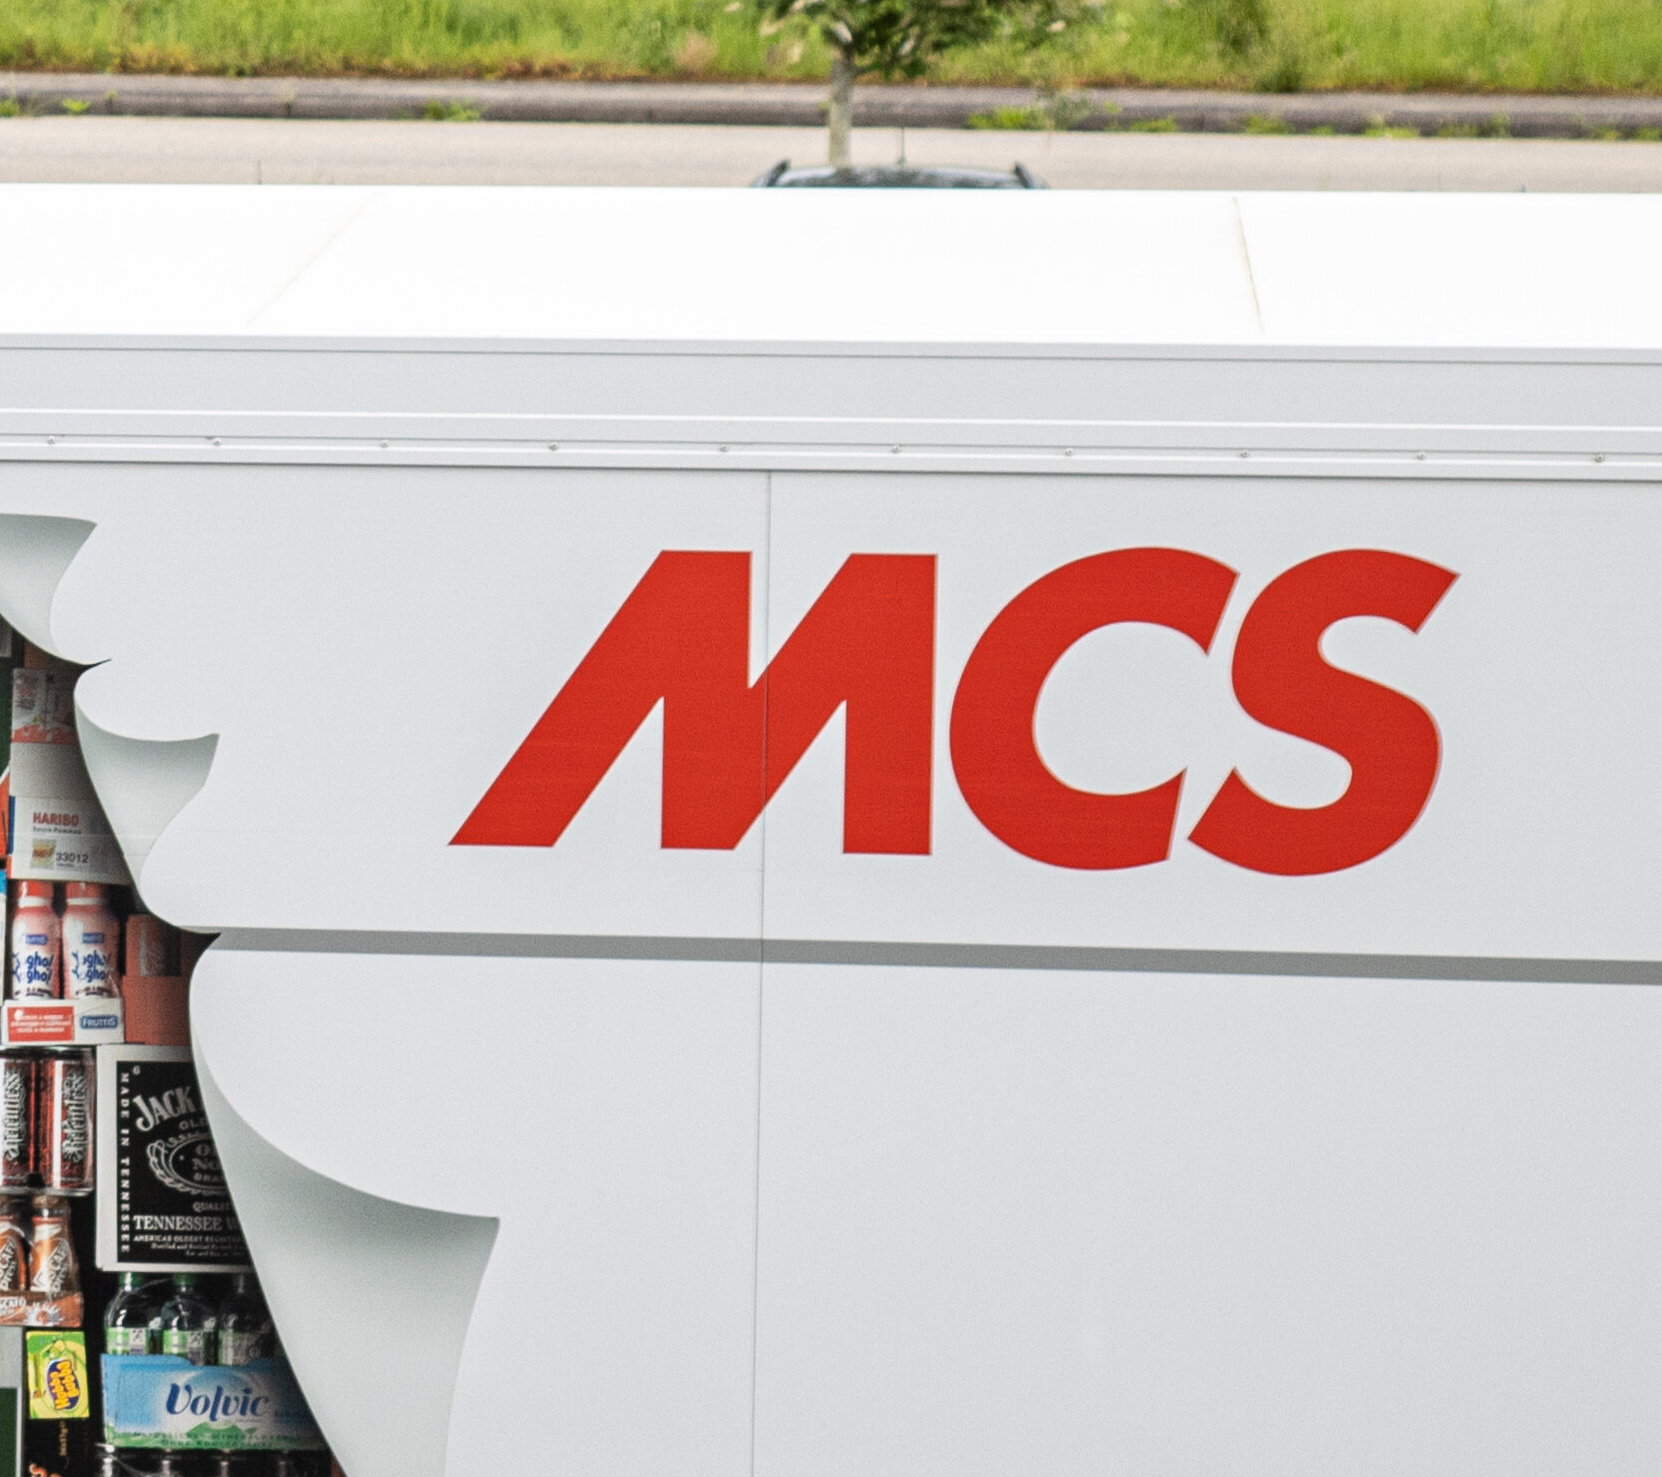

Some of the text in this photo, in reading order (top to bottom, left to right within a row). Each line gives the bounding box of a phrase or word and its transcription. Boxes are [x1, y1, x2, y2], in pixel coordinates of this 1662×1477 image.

[447, 545, 1464, 877] MCS
[32, 812, 79, 825] HARIBO
[56, 851, 89, 865] 33012
[132, 1086, 196, 1132] JACK
[121, 1073, 130, 1252] MADE IN TENNESSEE
[133, 1215, 223, 1231] TENNESSEE
[164, 1383, 269, 1421] Volvic
